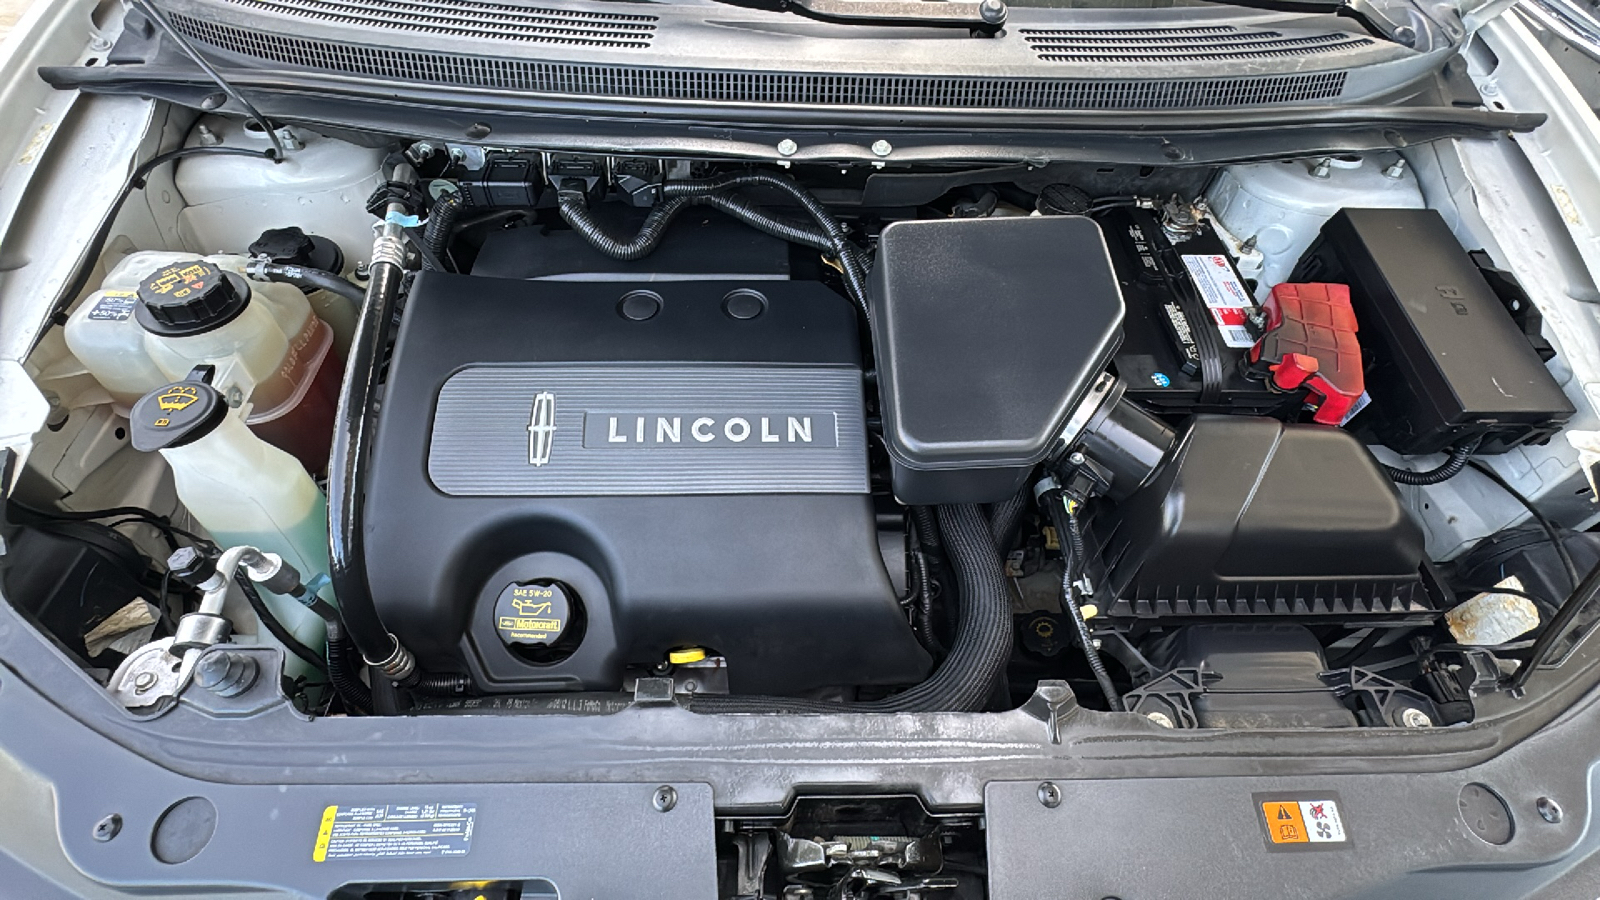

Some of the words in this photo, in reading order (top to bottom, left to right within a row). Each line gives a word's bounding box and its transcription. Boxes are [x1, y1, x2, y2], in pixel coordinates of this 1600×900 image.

[608, 417, 813, 443] LINCOLN
[513, 589, 528, 597] SAE
[529, 590, 552, 598] 5W-20
[516, 620, 558, 630] Motorcraft
